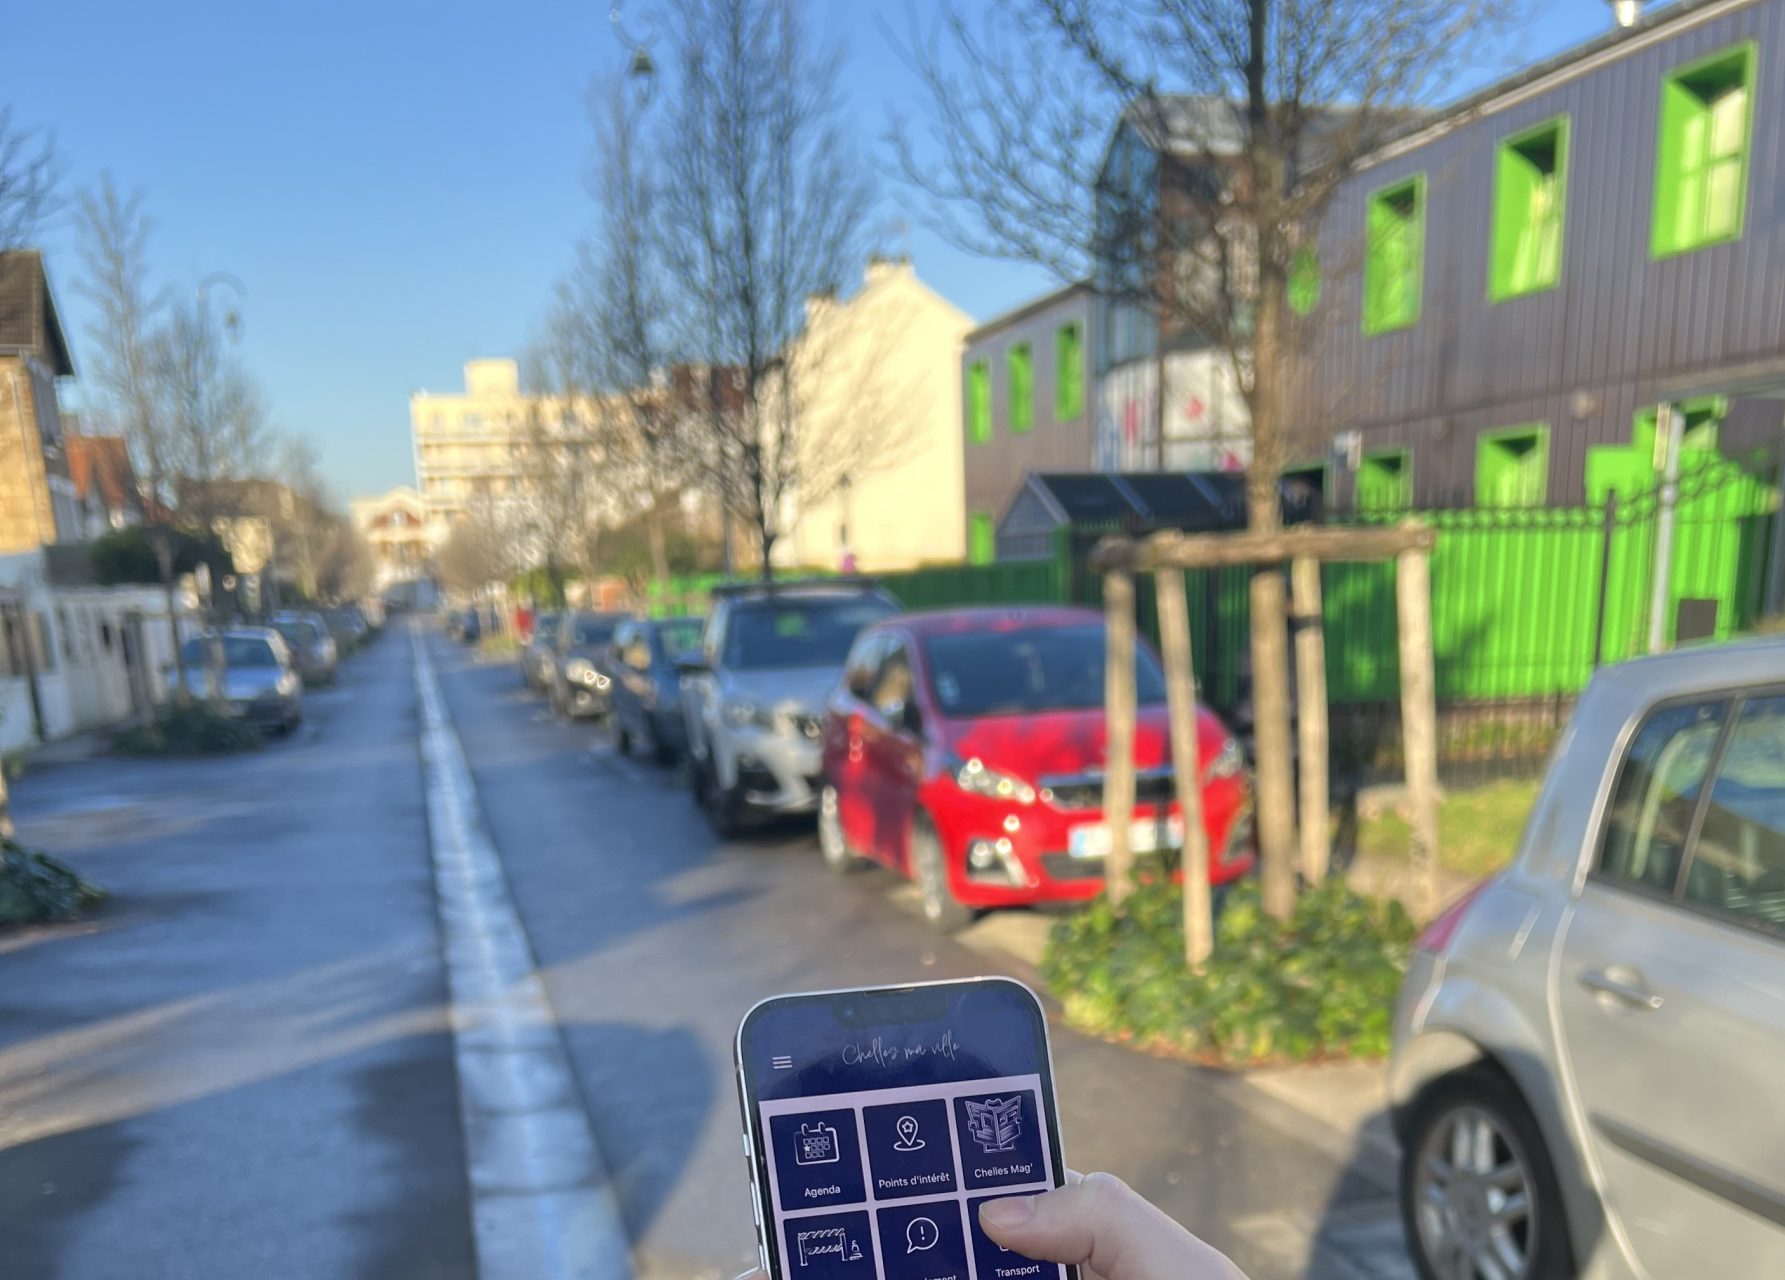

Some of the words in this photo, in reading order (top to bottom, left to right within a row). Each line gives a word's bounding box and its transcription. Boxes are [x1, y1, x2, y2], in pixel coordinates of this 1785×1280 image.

[973, 1165, 1008, 1179] Chelles
[1010, 1163, 1033, 1177] Mag'
[878, 1175, 908, 1189] Points
[910, 1171, 951, 1187] d'intérêt
[804, 1184, 841, 1199] Agenda
[995, 1263, 1041, 1278] Transport
